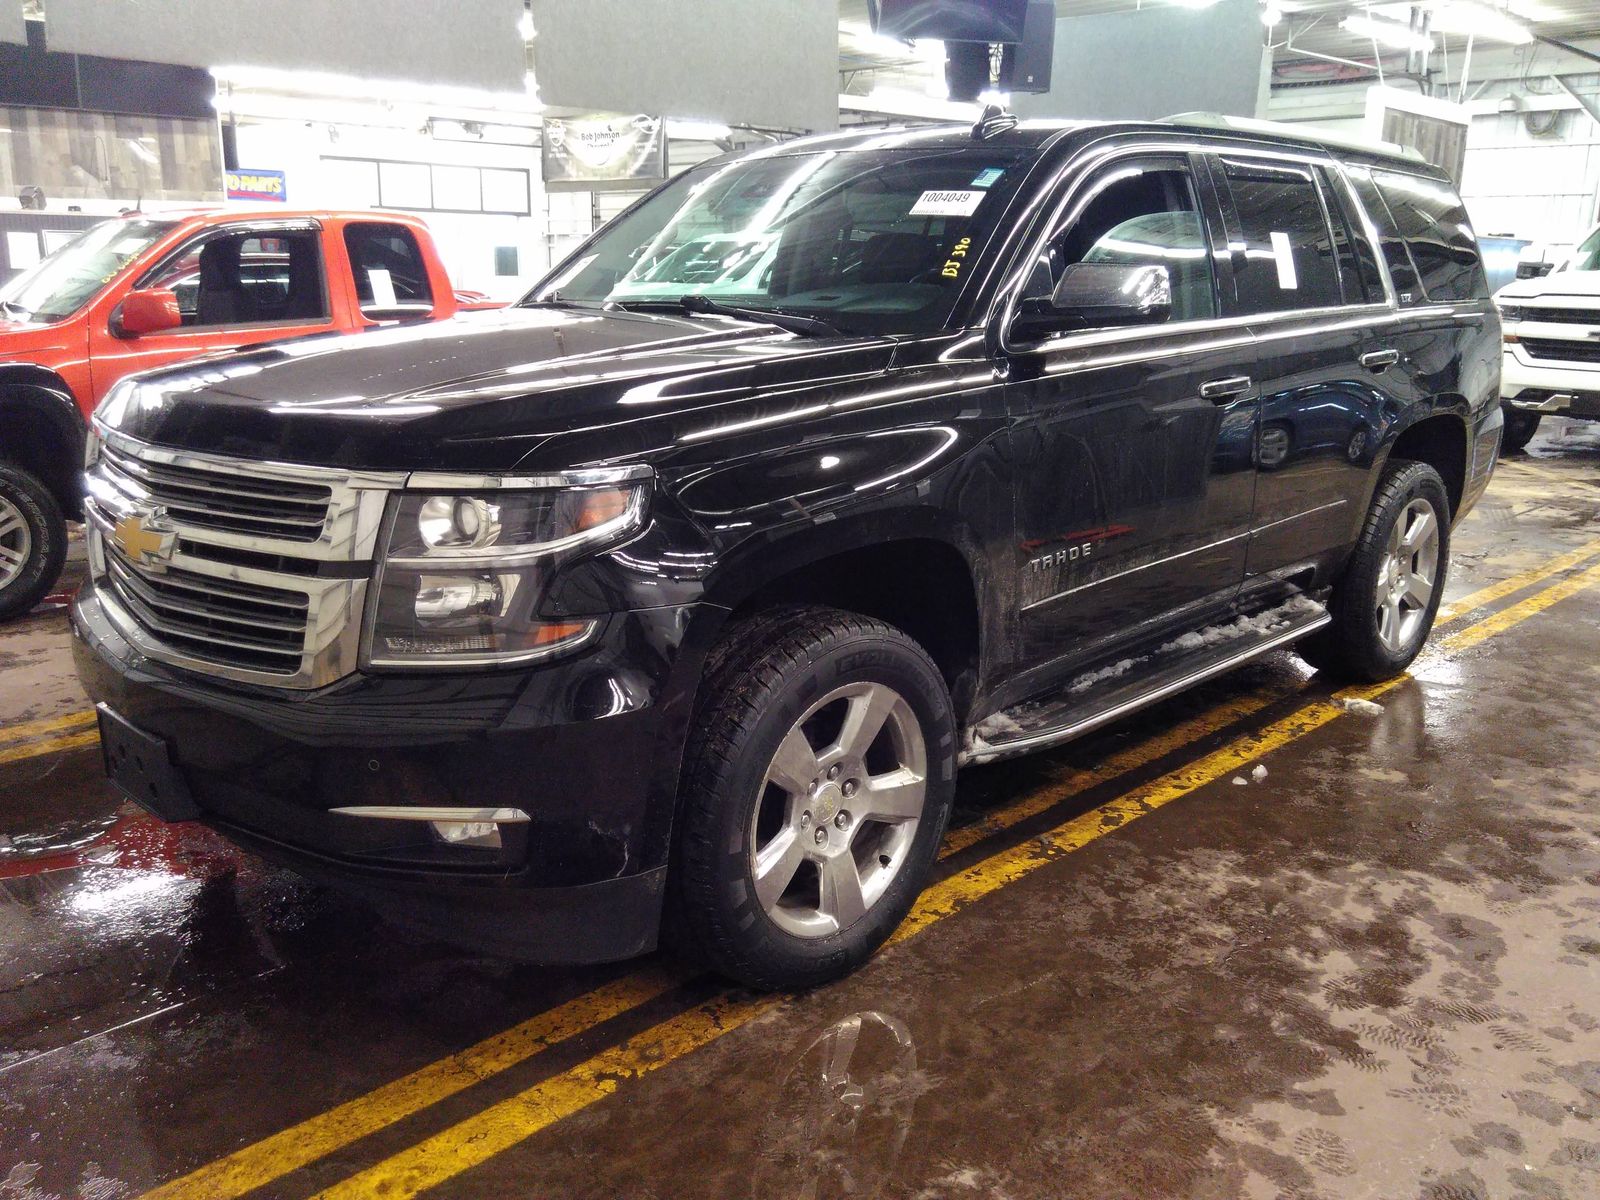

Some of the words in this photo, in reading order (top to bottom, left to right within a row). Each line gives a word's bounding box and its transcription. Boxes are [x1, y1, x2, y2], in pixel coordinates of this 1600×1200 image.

[581, 132, 593, 141] Bob
[594, 131, 620, 142] Johnson
[240, 175, 281, 193] PARTS
[922, 192, 971, 203] 1004049
[941, 259, 961, 278] BJ
[952, 237, 971, 258] 390
[1031, 542, 1091, 572] TAHOE
